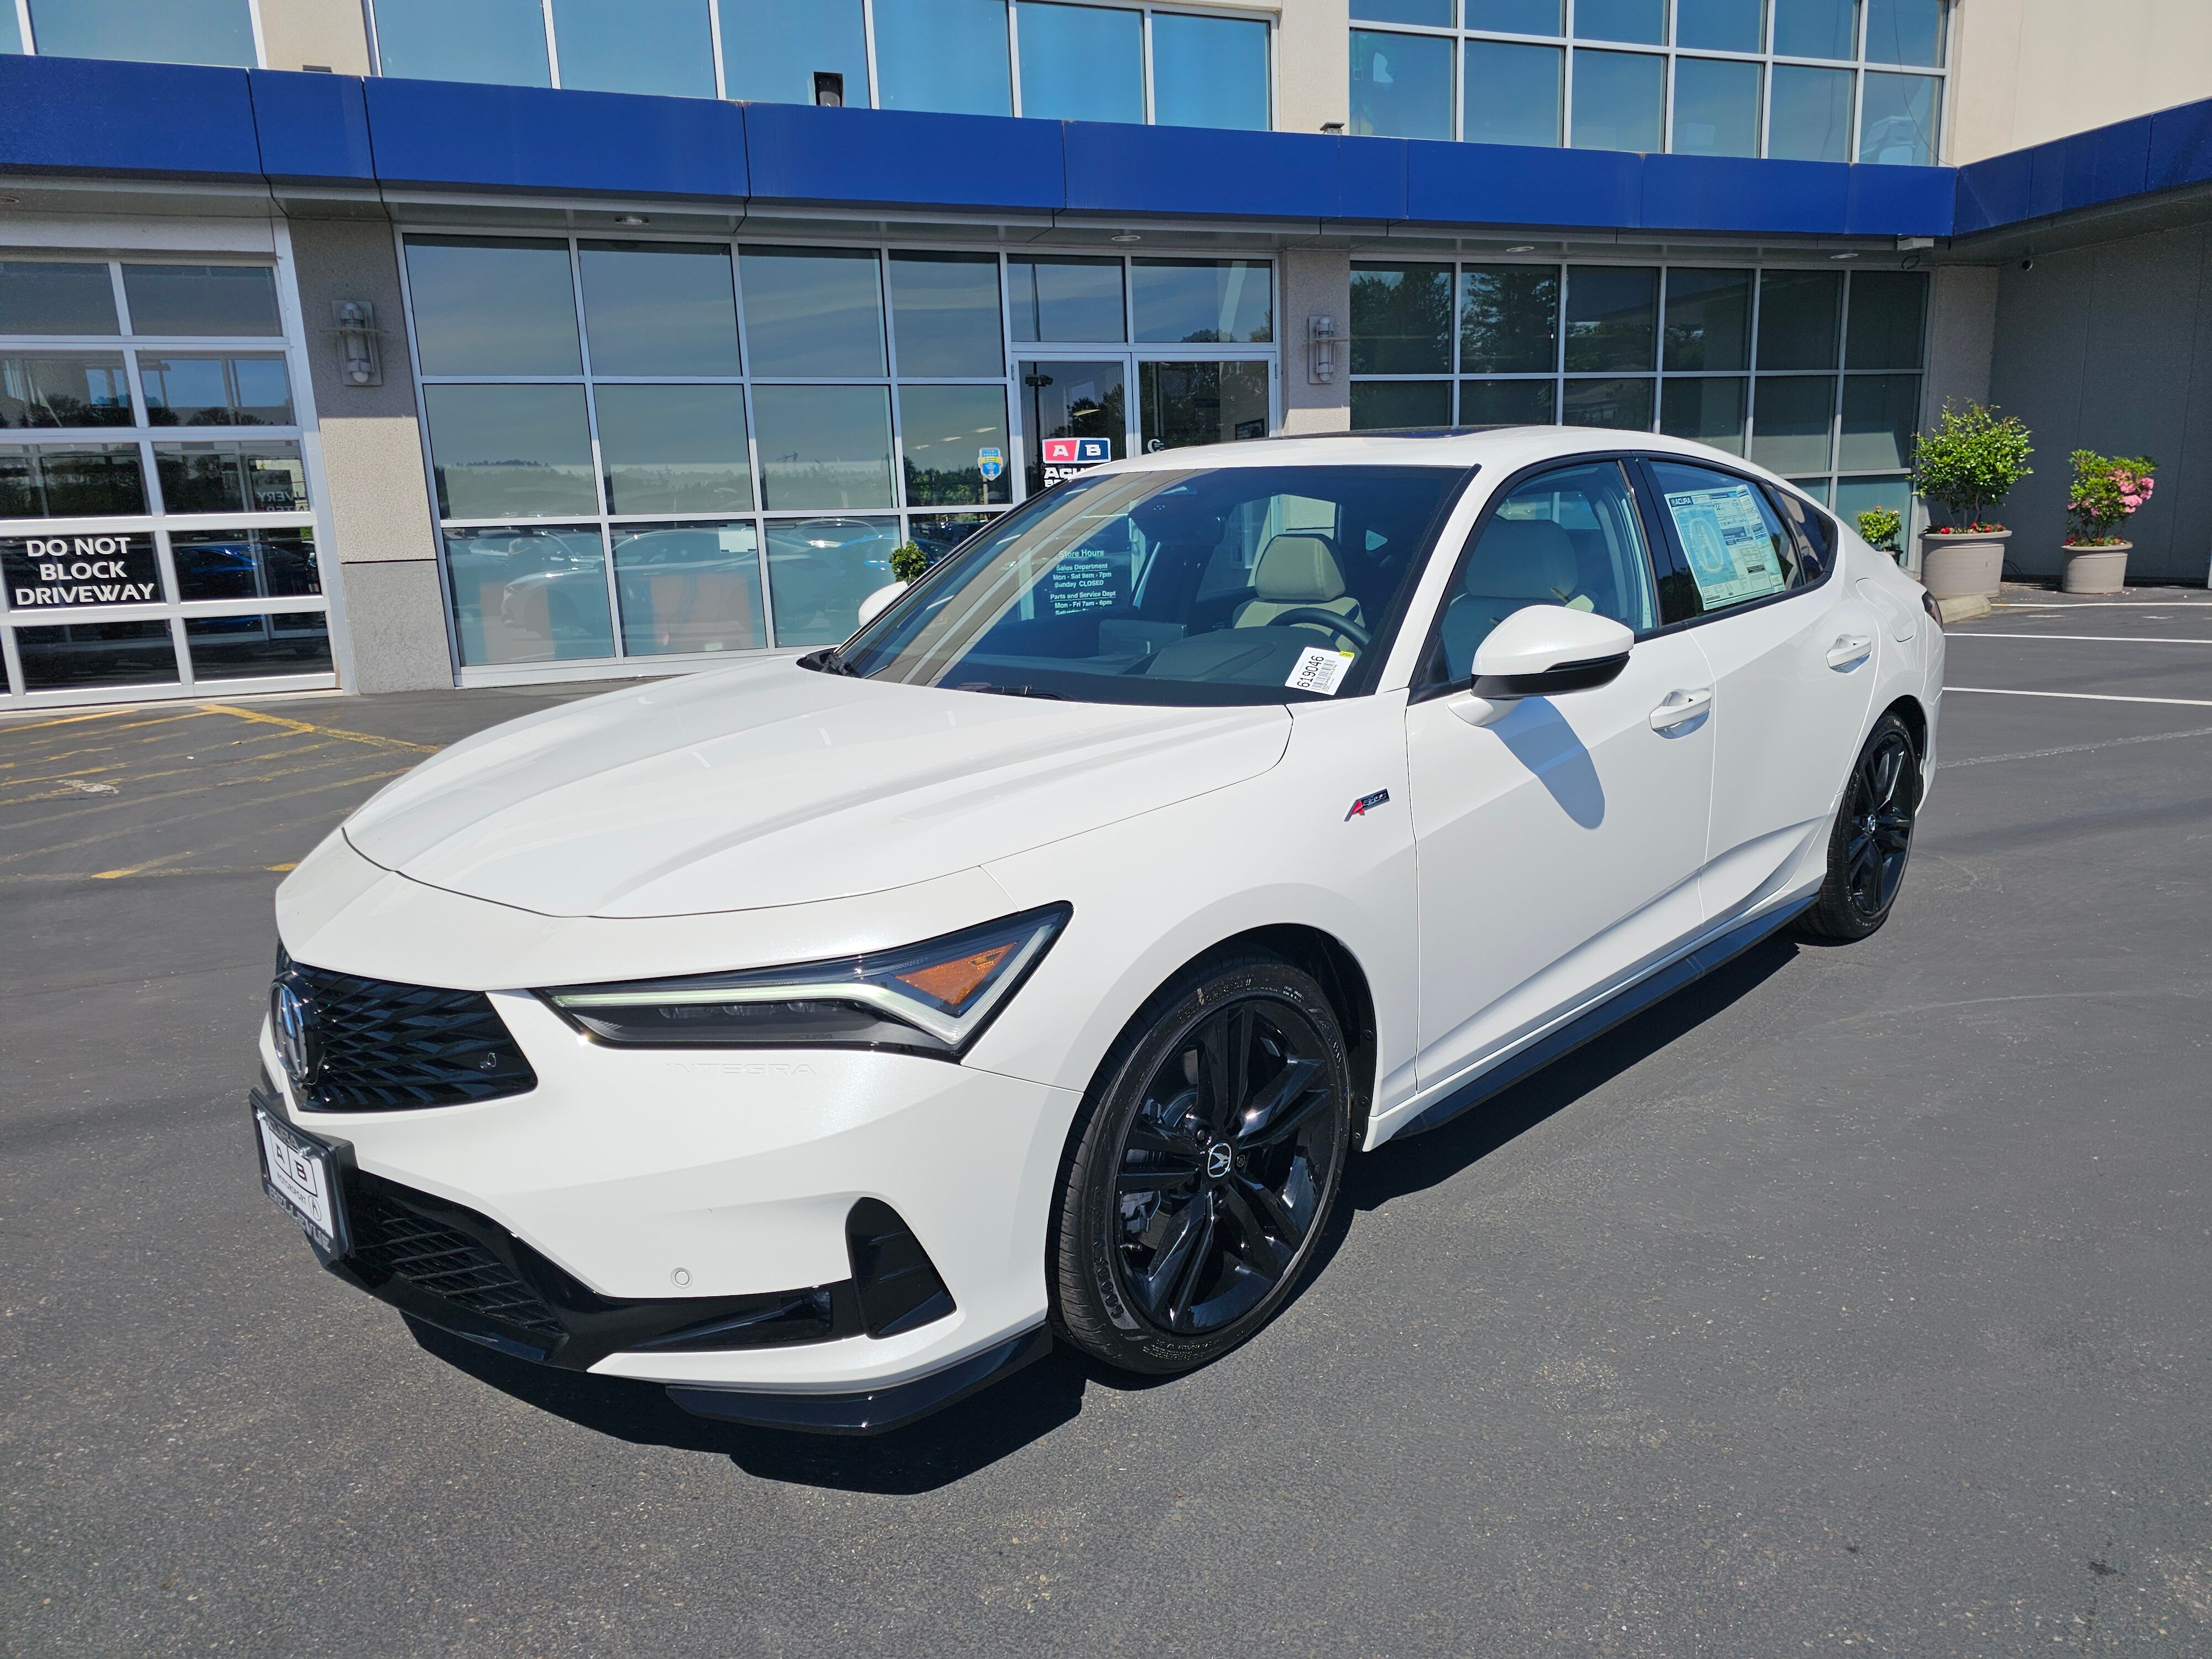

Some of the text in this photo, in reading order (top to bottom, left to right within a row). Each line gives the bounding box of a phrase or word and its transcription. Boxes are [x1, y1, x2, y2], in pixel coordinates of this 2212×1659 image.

[1053, 444, 1101, 457] A B
[26, 537, 131, 557] DO NOT
[1081, 549, 1104, 557] Hours
[39, 561, 128, 581] BLOCK
[1074, 563, 1108, 571] Department
[15, 583, 154, 606] DRIVEWAY
[1297, 655, 1324, 688] 619046
[275, 1143, 308, 1182] A B
[277, 1171, 307, 1206] MOTORSPORT
[267, 1183, 331, 1254] BELLEVUE
